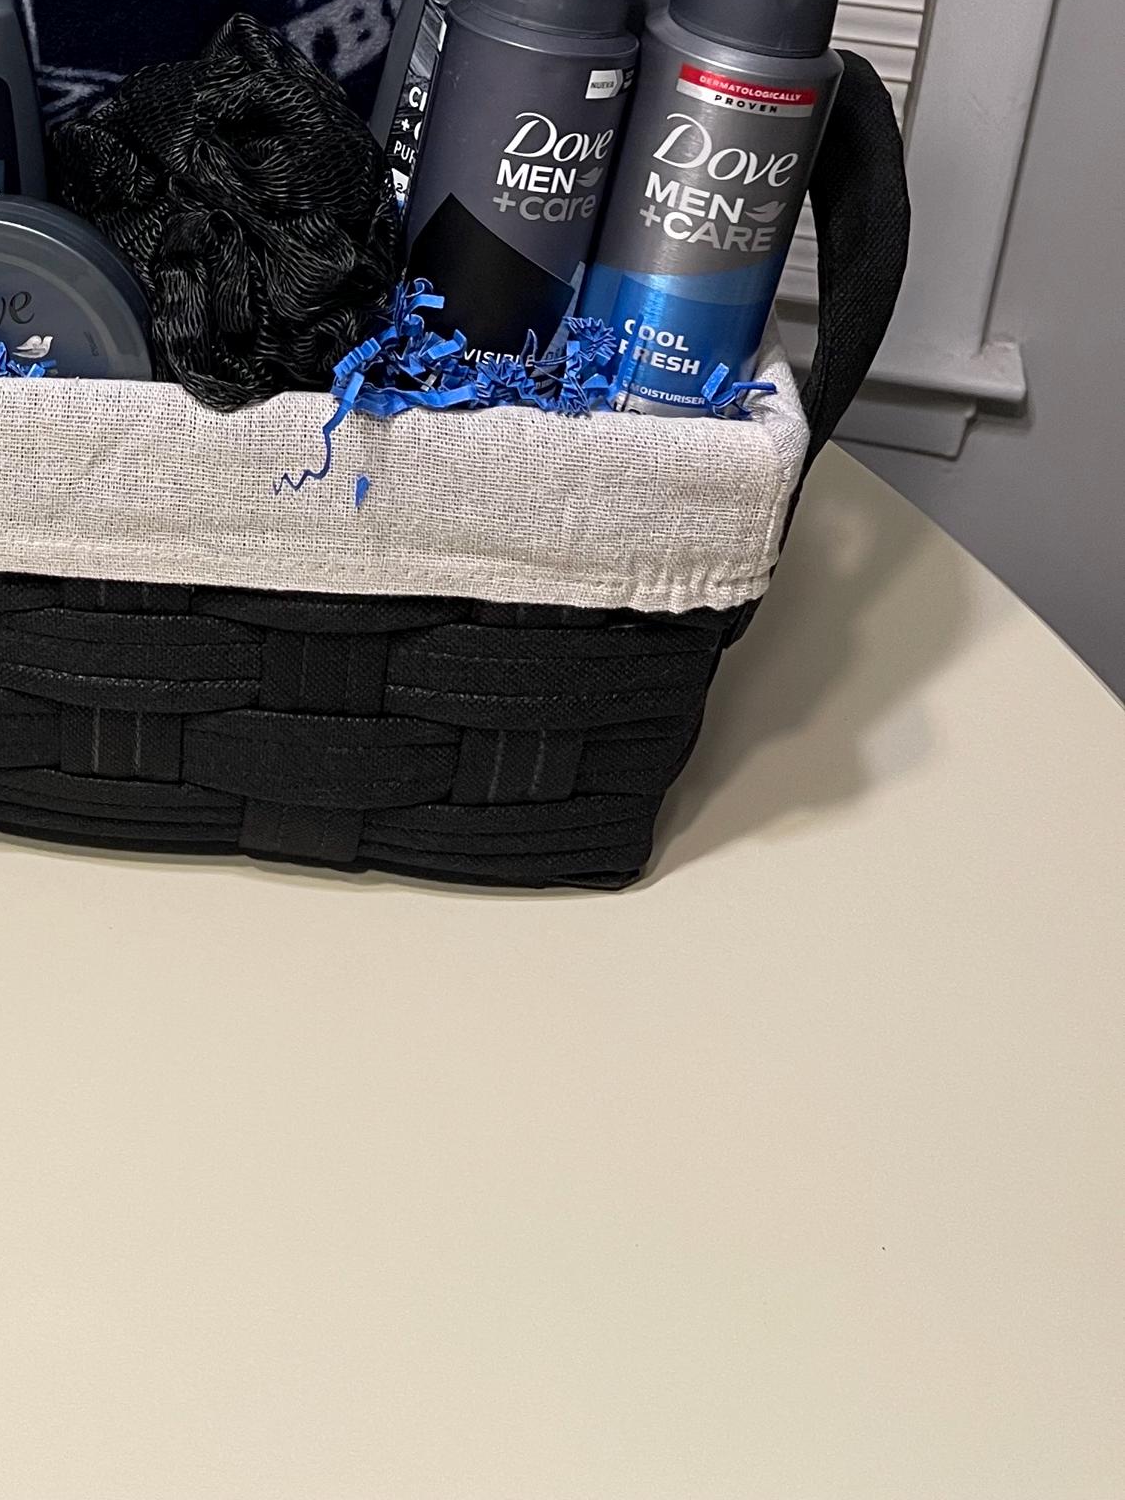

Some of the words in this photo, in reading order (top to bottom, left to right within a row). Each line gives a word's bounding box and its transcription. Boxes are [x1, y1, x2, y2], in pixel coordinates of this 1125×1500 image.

[698, 74, 803, 102] DERMATOLOGICALLY
[714, 94, 779, 114] PROVEN
[503, 111, 615, 162] Dove
[652, 112, 799, 187] Dove
[495, 158, 577, 194] MEN
[492, 191, 597, 222] +care
[644, 171, 744, 224] MEN
[639, 204, 777, 252] +CARE
[624, 318, 690, 352] COOL
